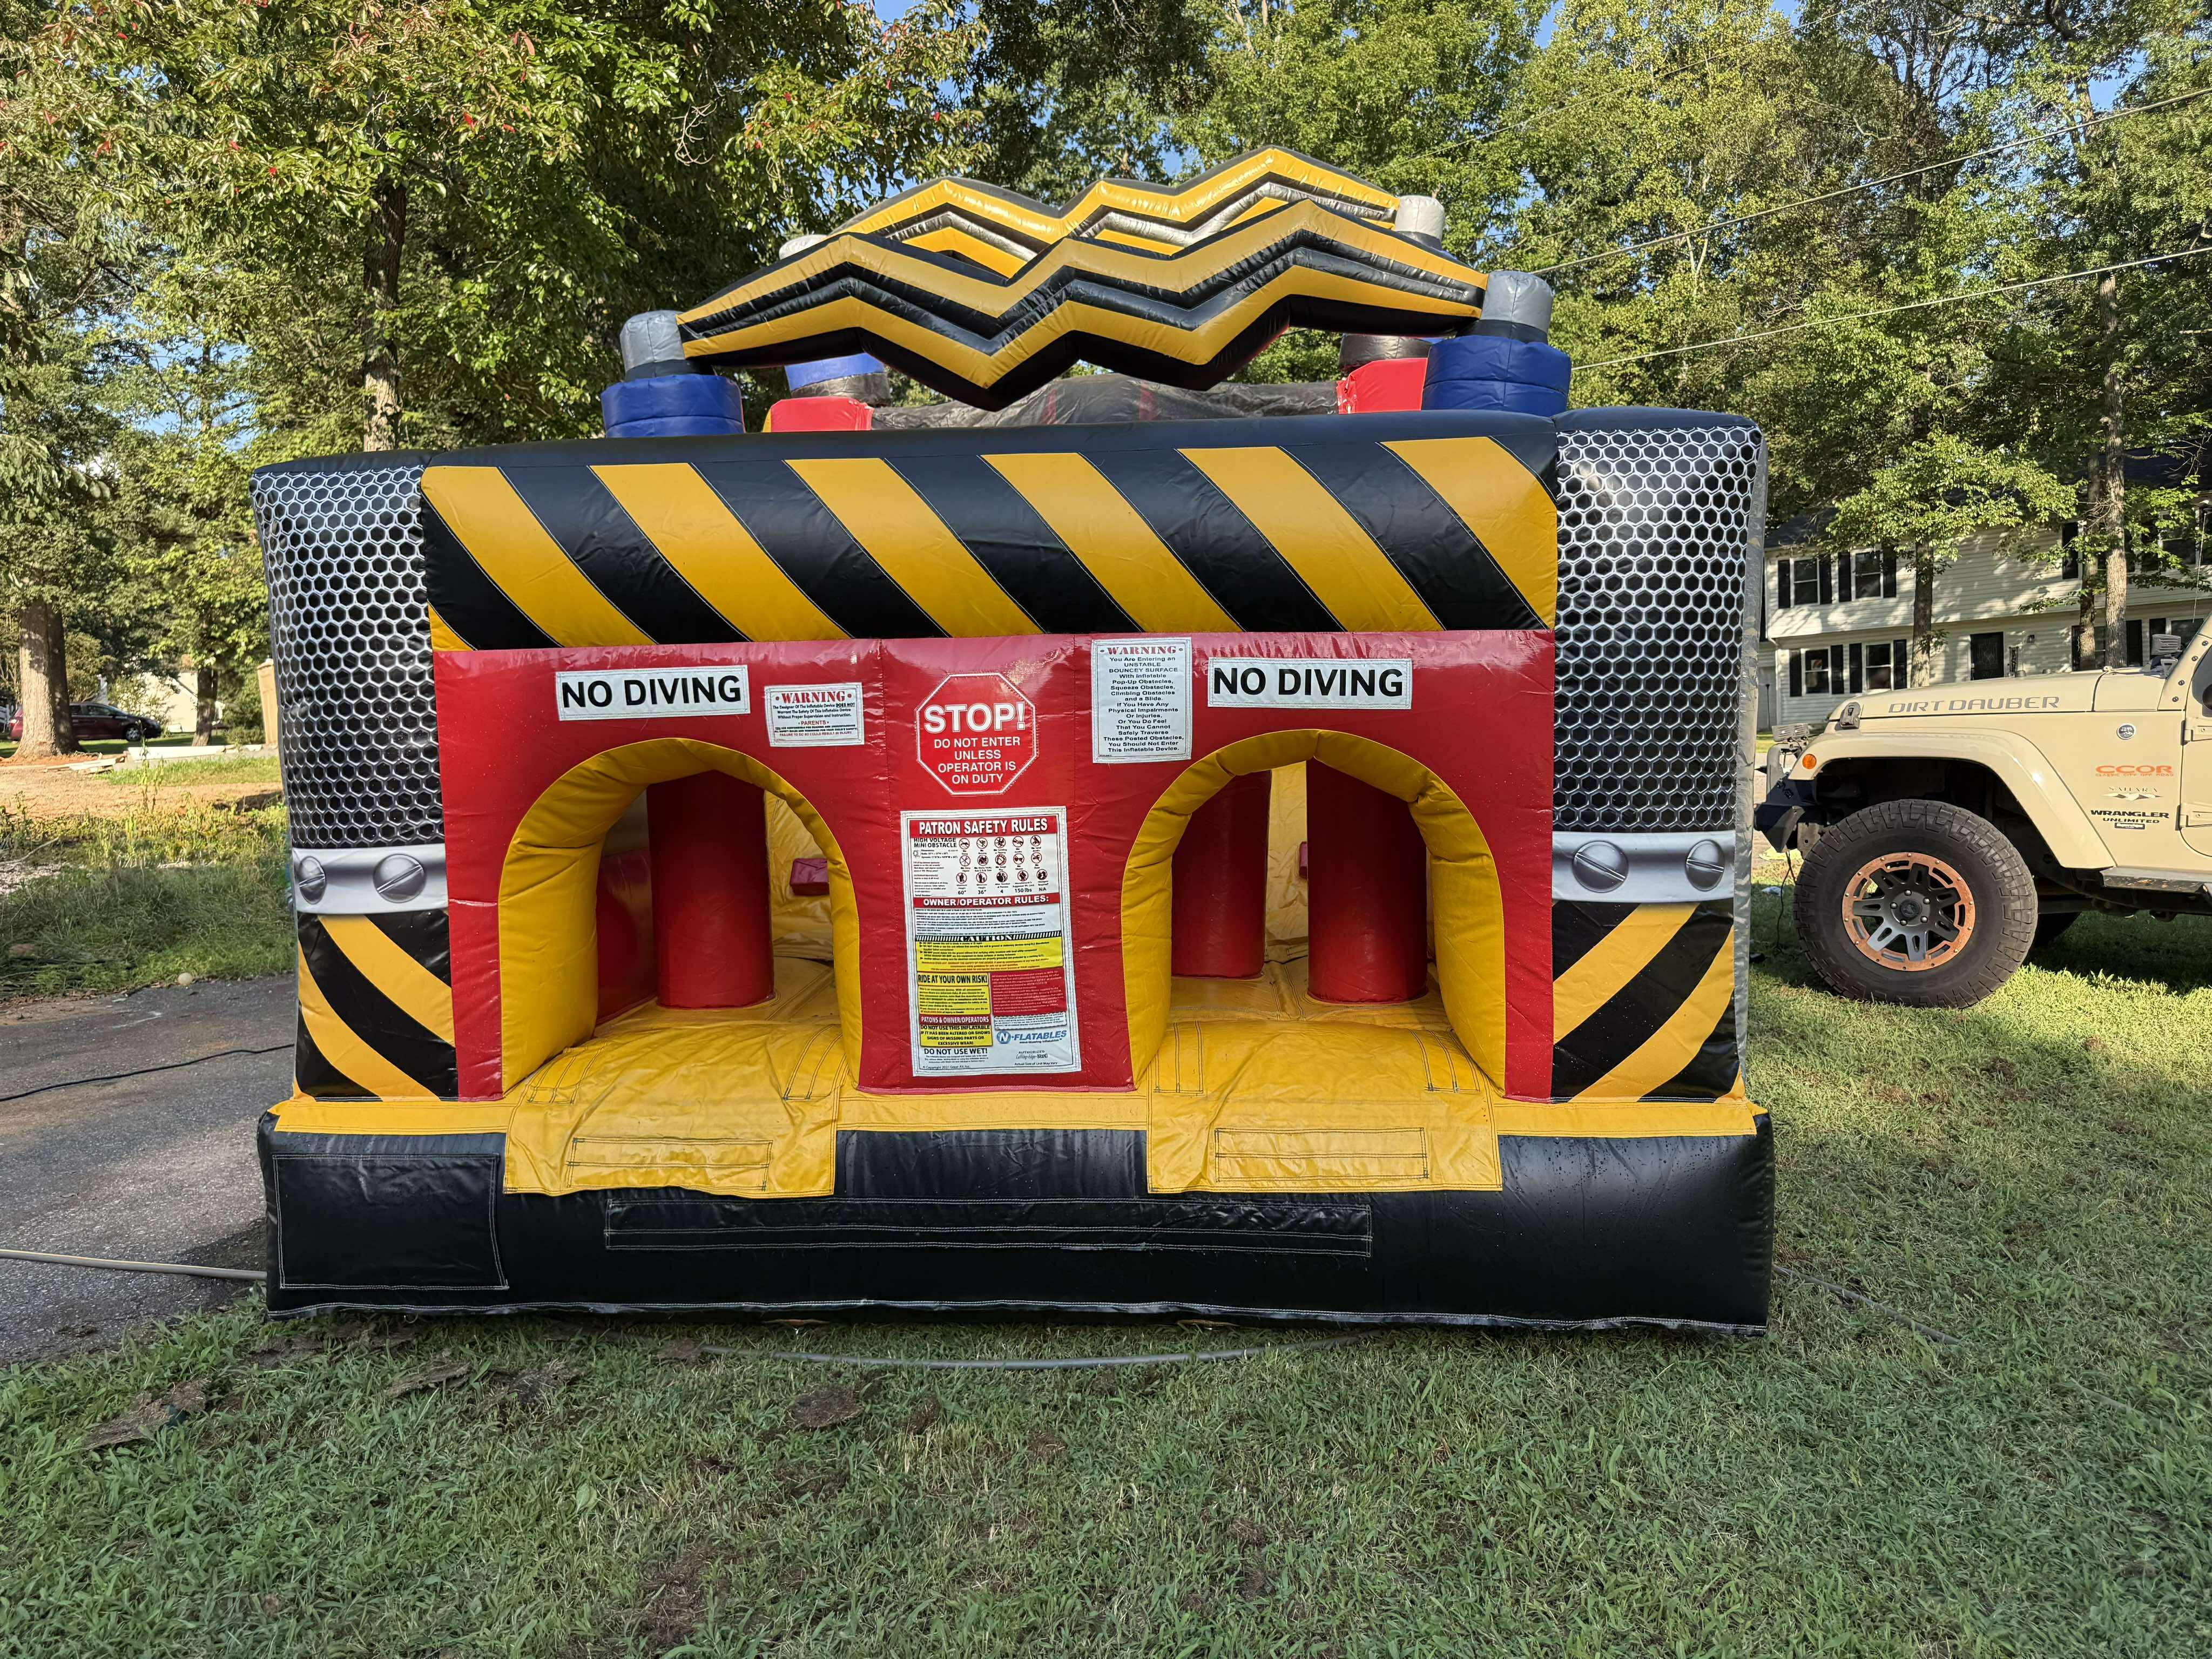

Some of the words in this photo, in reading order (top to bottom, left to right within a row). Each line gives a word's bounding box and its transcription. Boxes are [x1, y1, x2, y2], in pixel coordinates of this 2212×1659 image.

[1107, 646, 1176, 655] WARNING
[1214, 668, 1266, 694] NO
[1278, 669, 1402, 697] DIVING
[562, 680, 612, 708] NO
[624, 675, 741, 706] DIVING
[781, 691, 845, 703] WARNING
[1889, 701, 1944, 712] DIRT
[1948, 697, 2059, 710] DAUBER
[924, 702, 1026, 733] STOP!
[934, 739, 950, 748] DO
[954, 738, 977, 747] NOT
[982, 737, 1020, 746] ENTER
[955, 750, 1001, 760] UNLESS
[938, 762, 1001, 772] OPERATOR
[1006, 761, 1016, 770] IS
[952, 775, 968, 784] ON
[973, 774, 1003, 783] DUTY
[2090, 810, 2169, 818] WRANGLER
[920, 822, 960, 834] PATRON
[965, 820, 1007, 833] SAFETY
[1011, 819, 1047, 832] RULES
[923, 898, 1011, 907] OWNER/OPERATOR
[1015, 895, 1049, 904] RULES:
[918, 975, 930, 983] RIDE
[939, 975, 955, 983] YOUR
